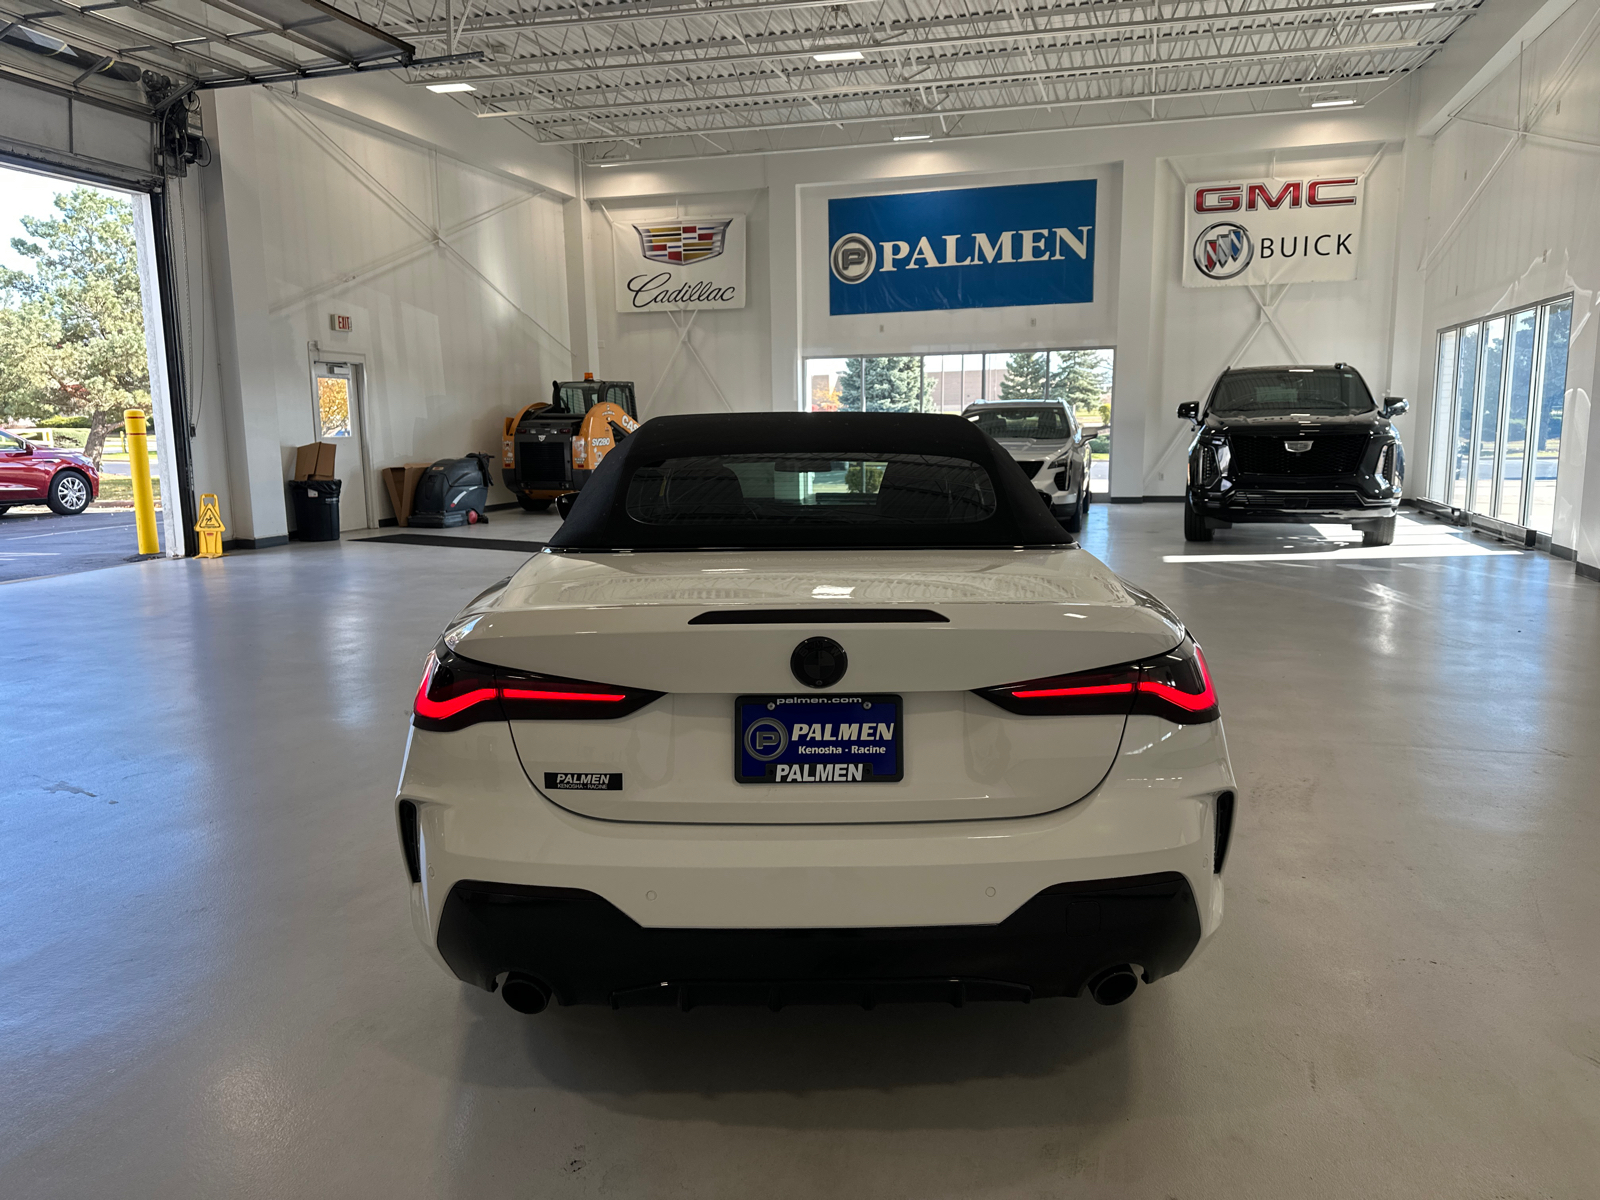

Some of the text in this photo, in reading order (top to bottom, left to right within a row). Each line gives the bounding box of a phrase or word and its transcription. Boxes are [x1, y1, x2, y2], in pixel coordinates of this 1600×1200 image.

[1194, 176, 1358, 214] GMC
[878, 226, 1093, 272] PALMEN
[1260, 233, 1353, 259] BUICK
[627, 272, 735, 308] Cadillac
[337, 315, 350, 330] EXIT
[622, 415, 640, 433] CAS
[798, 640, 842, 658] BMW
[776, 696, 862, 705] palmen.com
[791, 722, 895, 741] PALMEN
[798, 745, 842, 755] Kenosha
[851, 745, 886, 754] Racine
[556, 774, 610, 784] PALMEN
[775, 763, 864, 782] PALMEN
